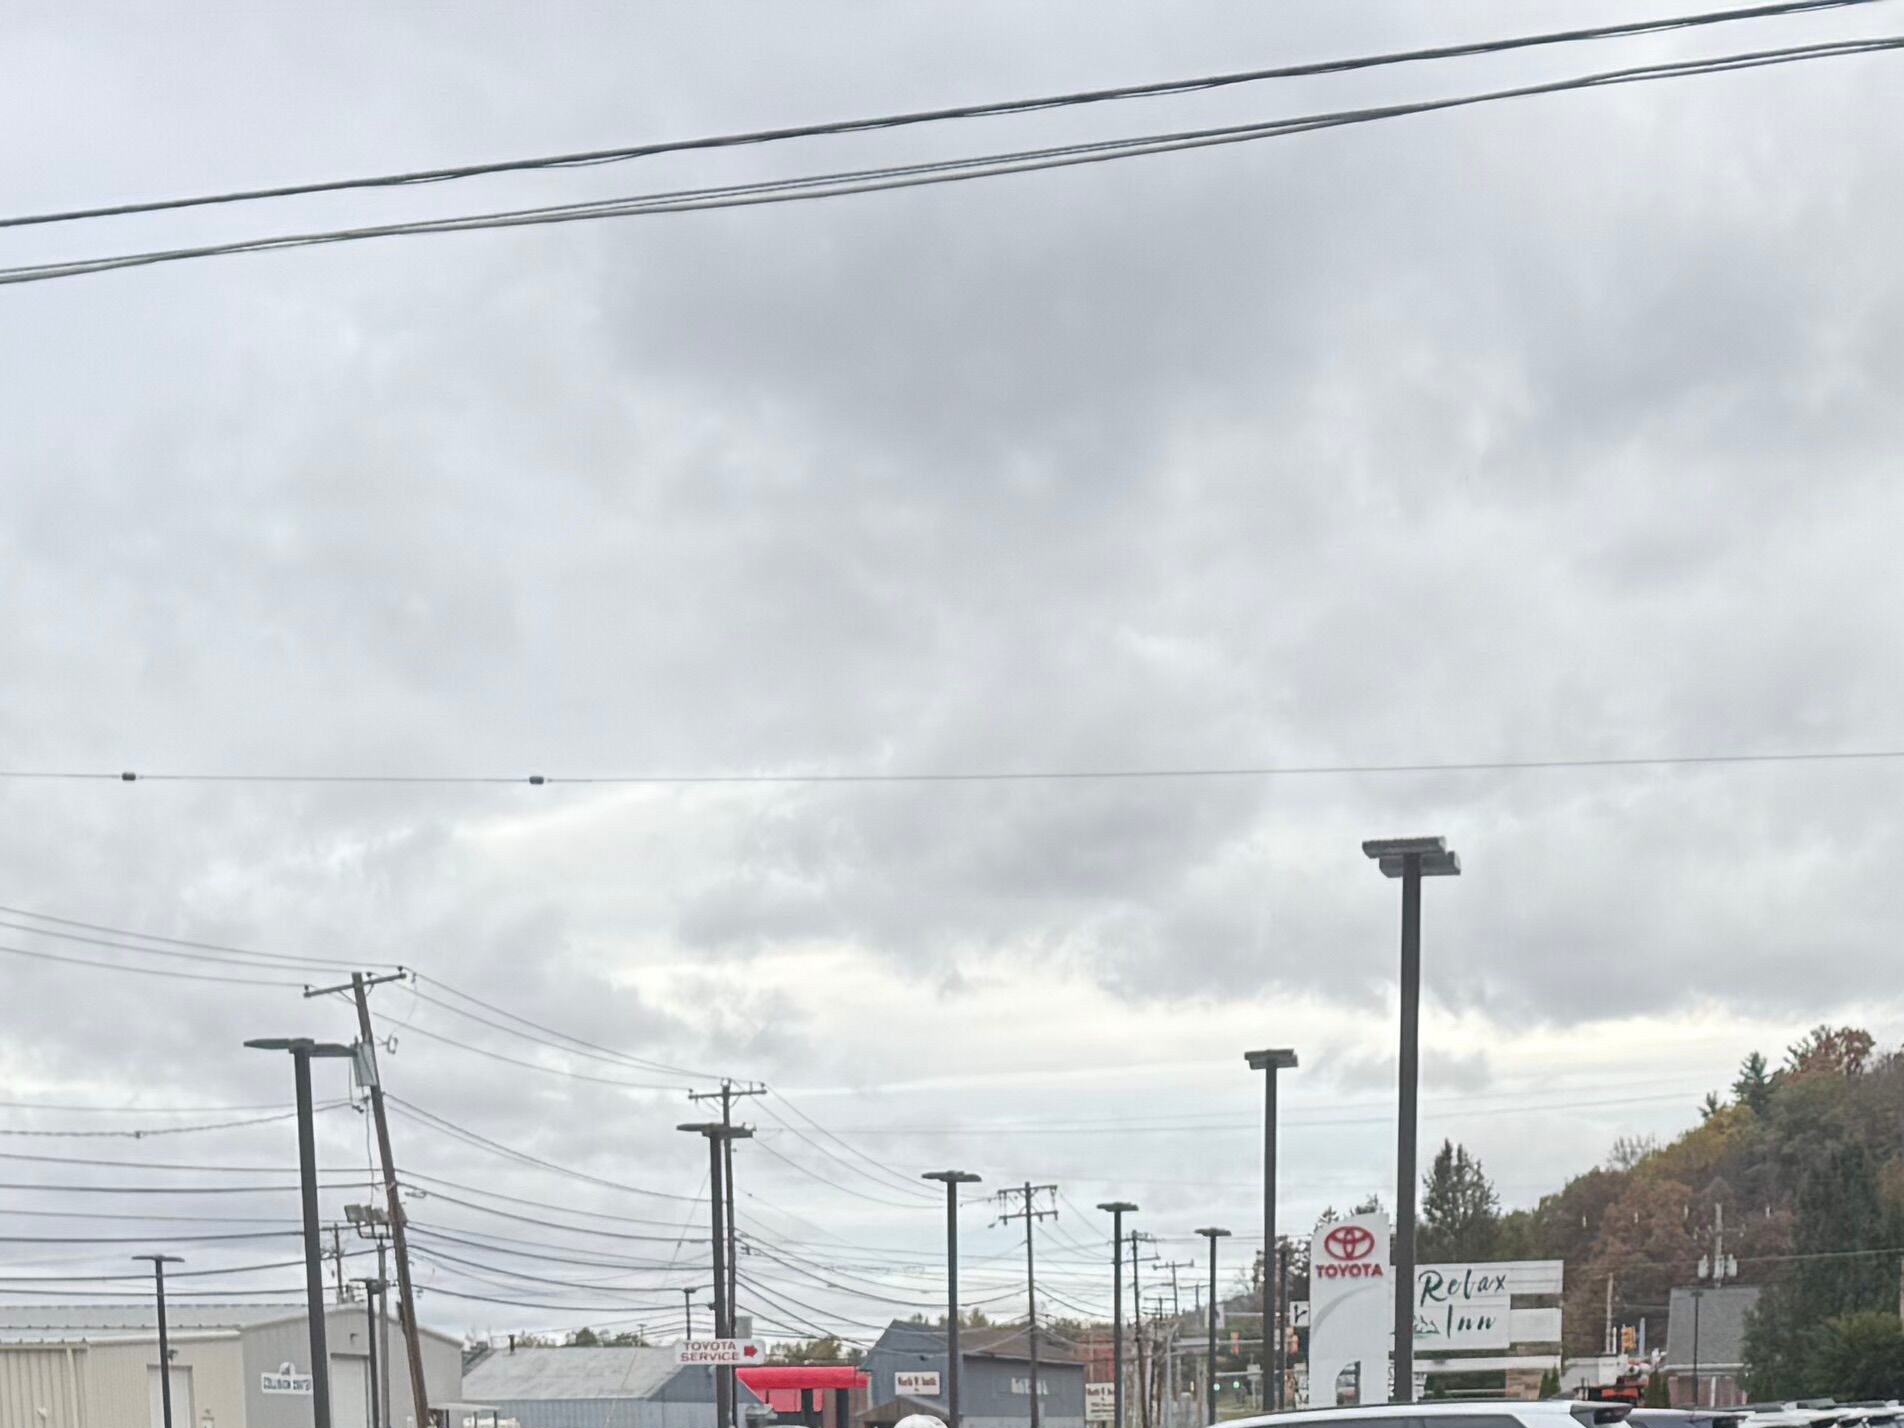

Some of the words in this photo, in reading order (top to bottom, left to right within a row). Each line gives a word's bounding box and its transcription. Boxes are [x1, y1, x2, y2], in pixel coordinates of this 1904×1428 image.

[1316, 1263, 1384, 1279] TOYOTA
[1417, 1268, 1506, 1307] Relax
[1447, 1304, 1496, 1339] Inn
[683, 1341, 736, 1351] TOYOTA
[680, 1351, 739, 1362] SERVICE
